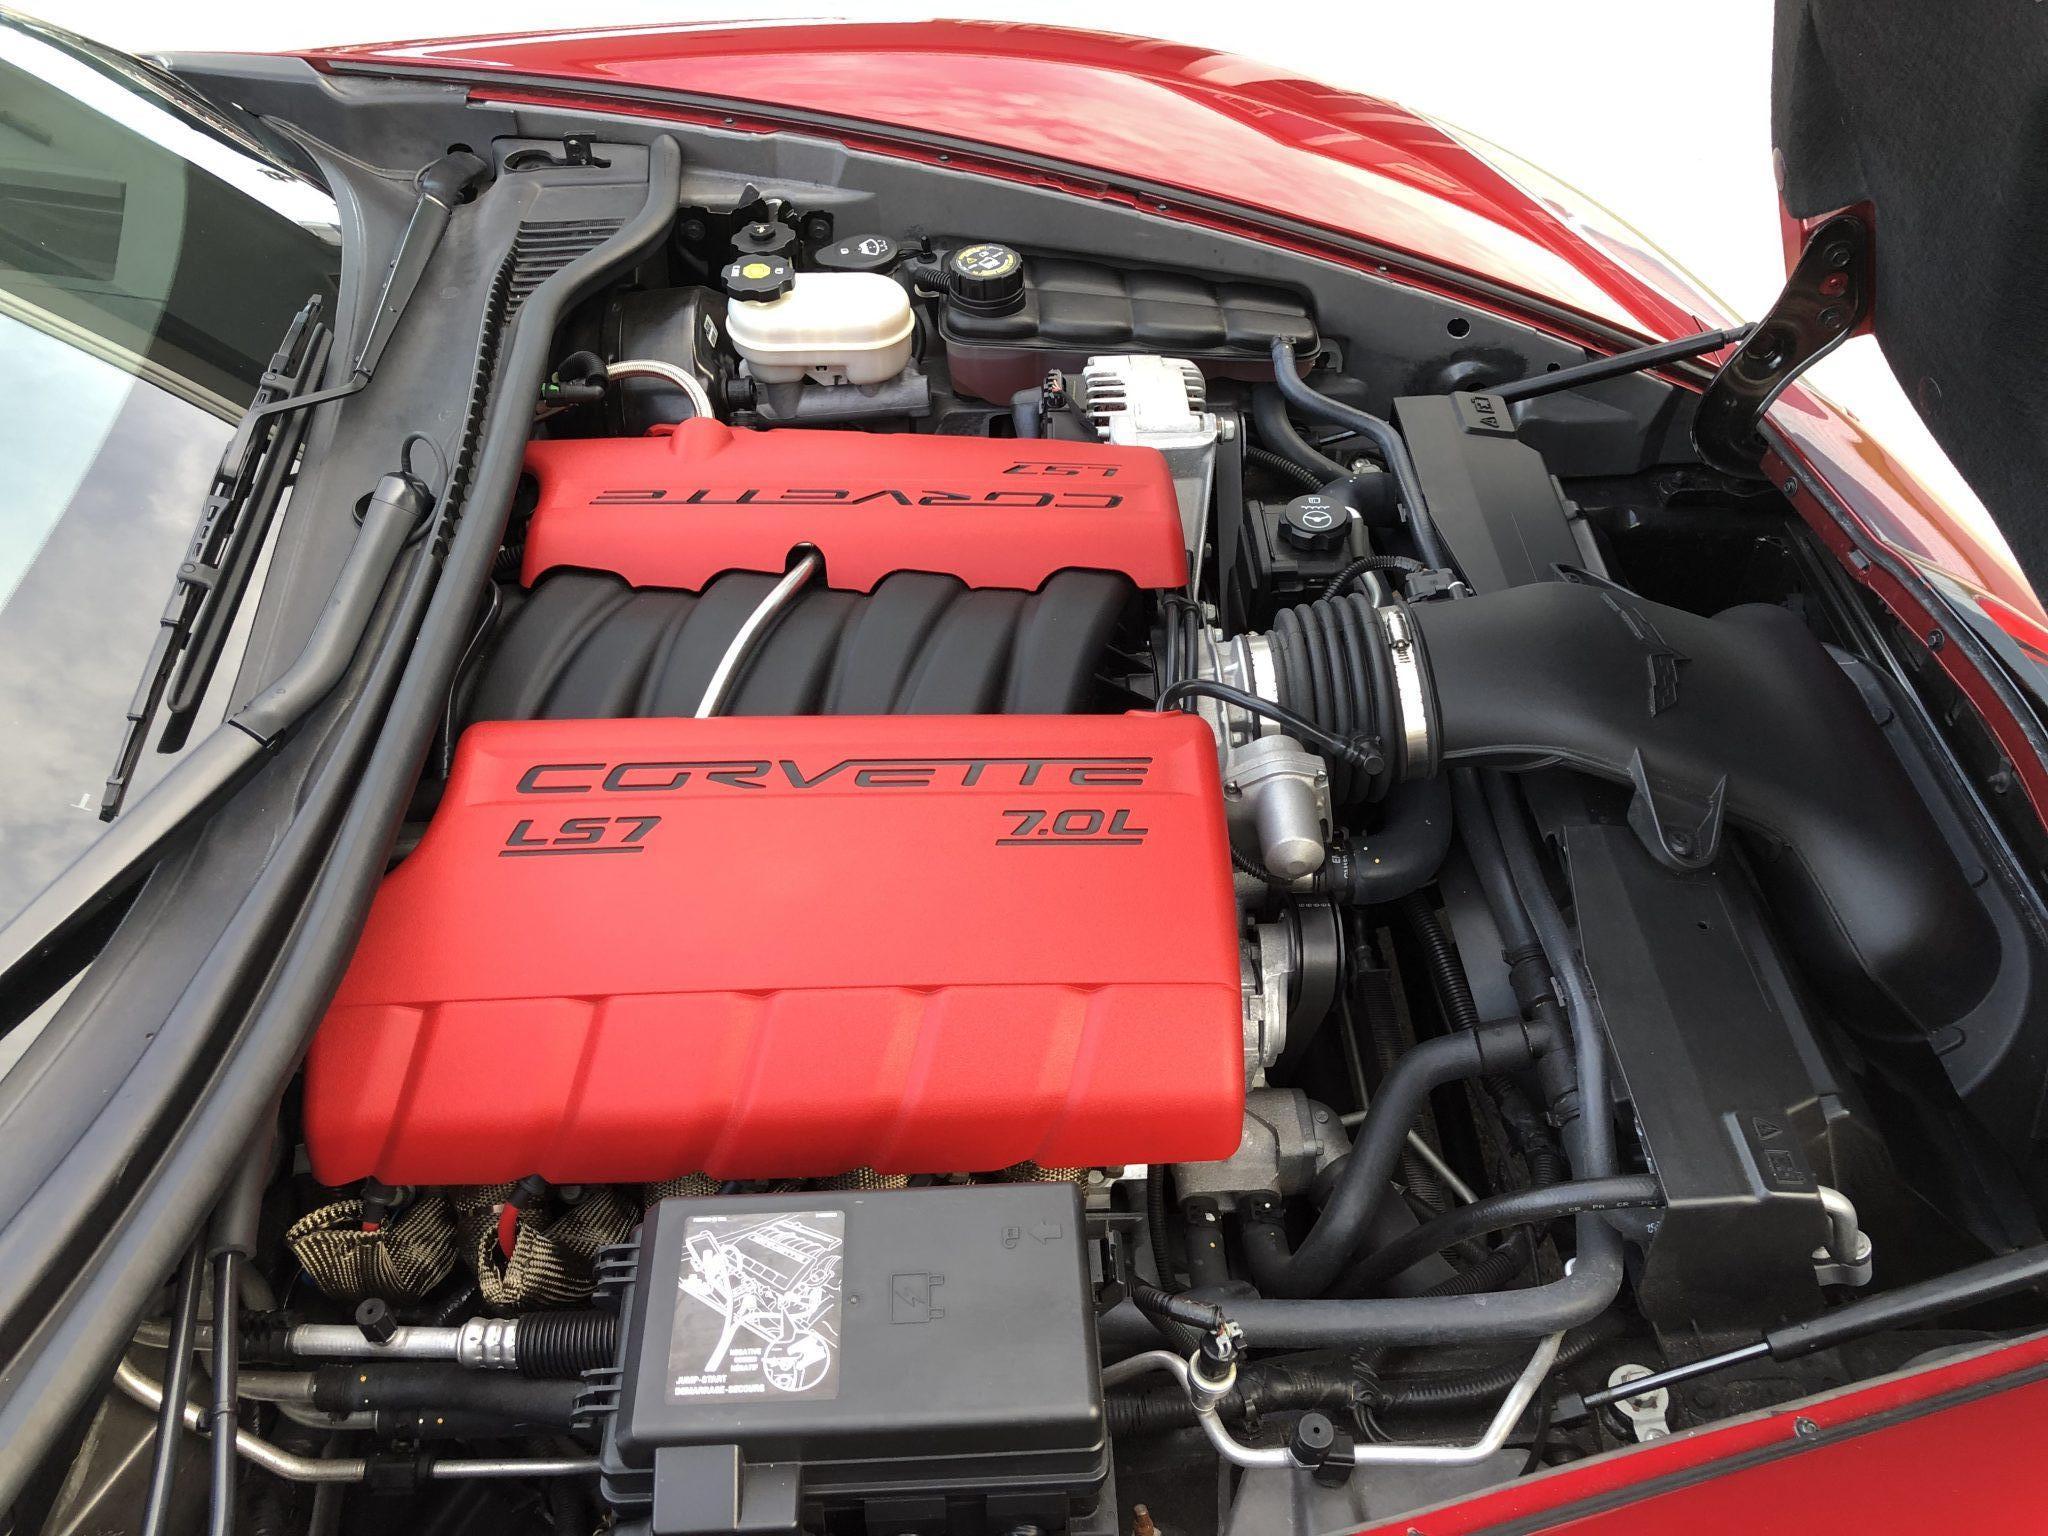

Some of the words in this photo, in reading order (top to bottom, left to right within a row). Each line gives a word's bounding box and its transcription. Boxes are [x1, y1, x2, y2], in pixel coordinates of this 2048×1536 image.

[1002, 464, 1119, 477] LS7
[588, 489, 1124, 509] CORVETTE
[516, 757, 1153, 794] CORVETTE
[505, 816, 662, 846] LS7
[1002, 809, 1149, 835] 7.0L
